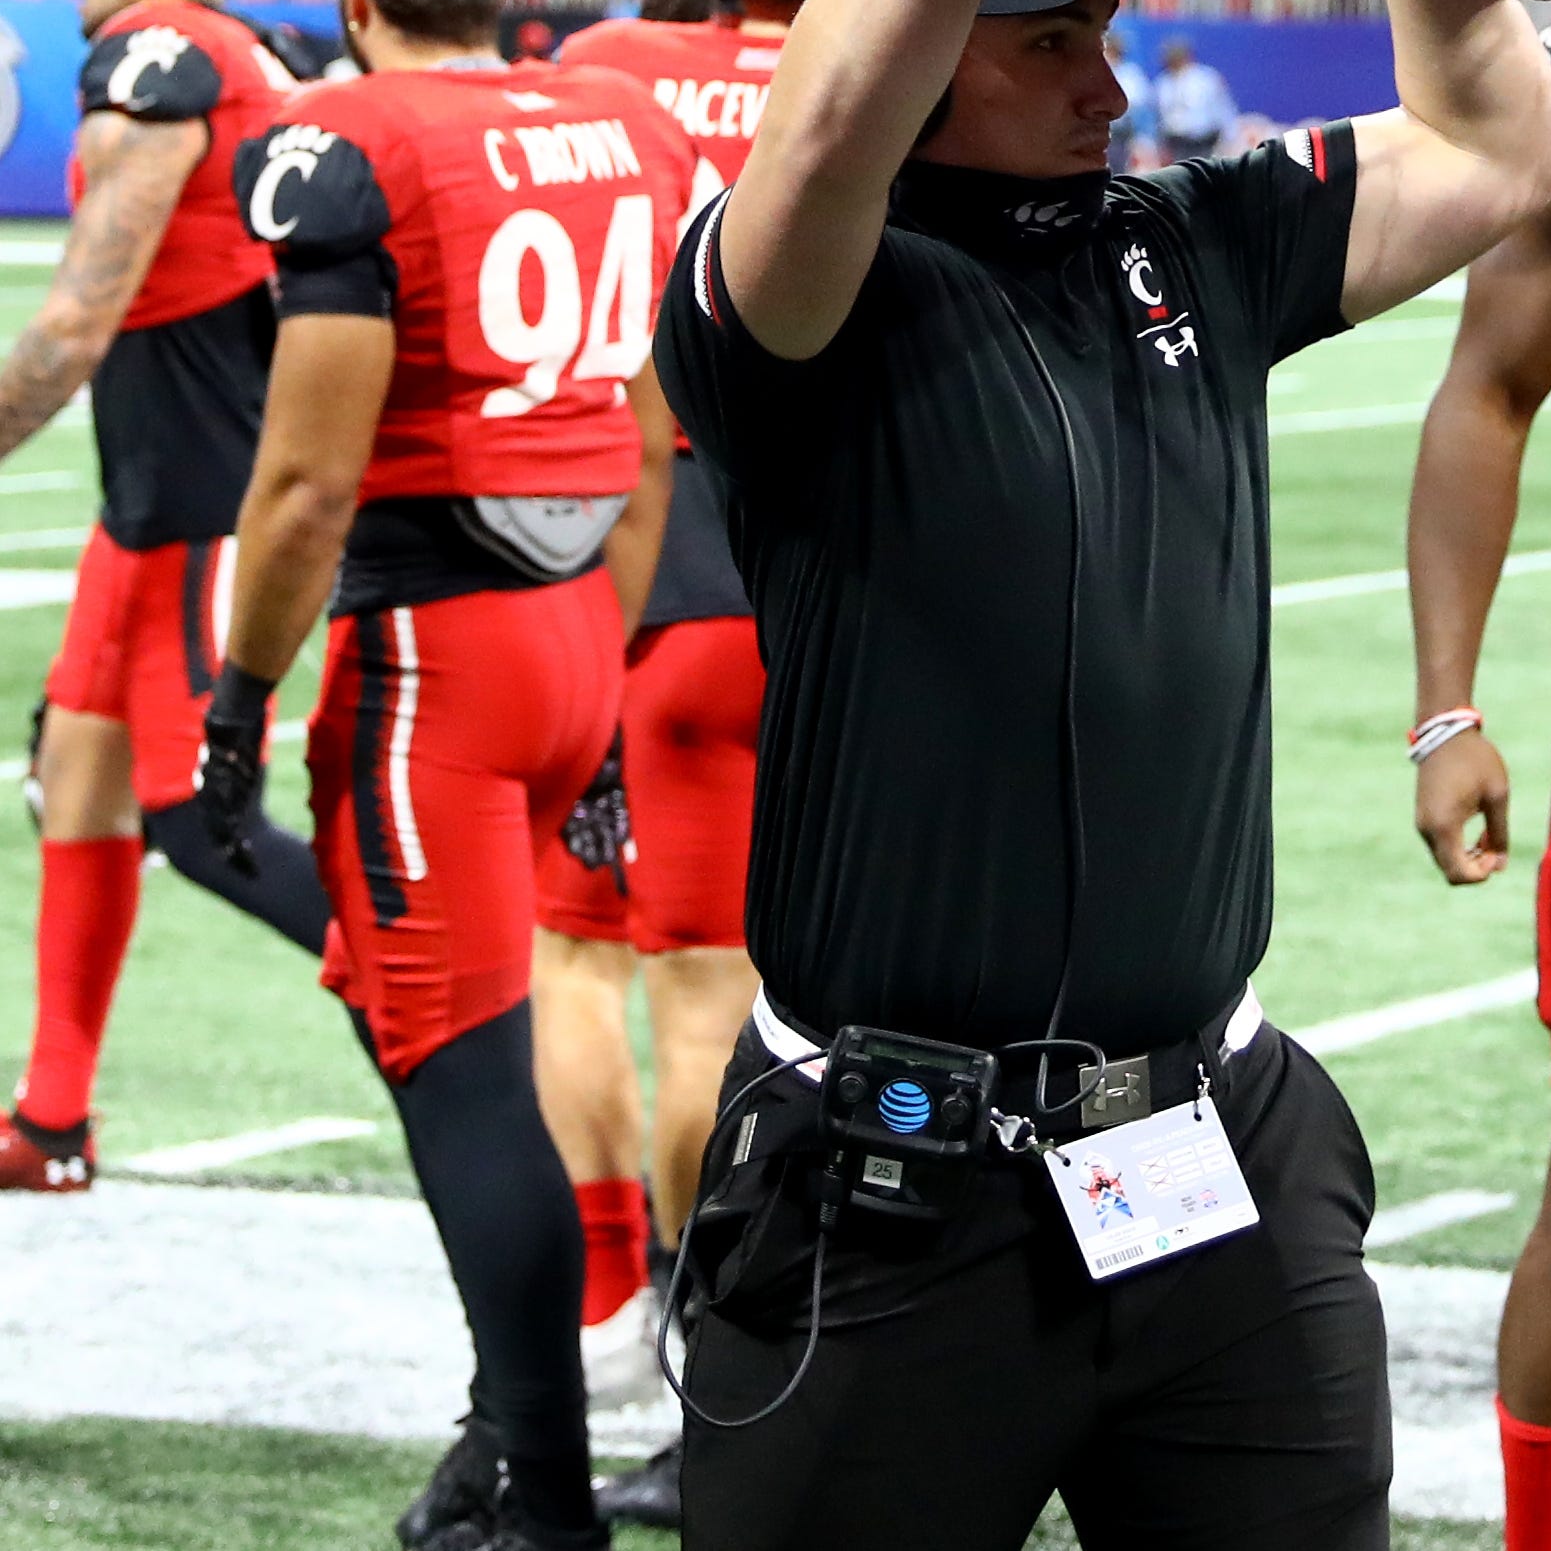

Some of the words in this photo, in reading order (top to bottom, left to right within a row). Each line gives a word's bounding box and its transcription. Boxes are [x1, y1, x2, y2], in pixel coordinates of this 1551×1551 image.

[483, 127, 520, 191] C
[513, 117, 643, 187] BROWN
[477, 193, 657, 418] 94
[872, 1162, 893, 1180] 25
